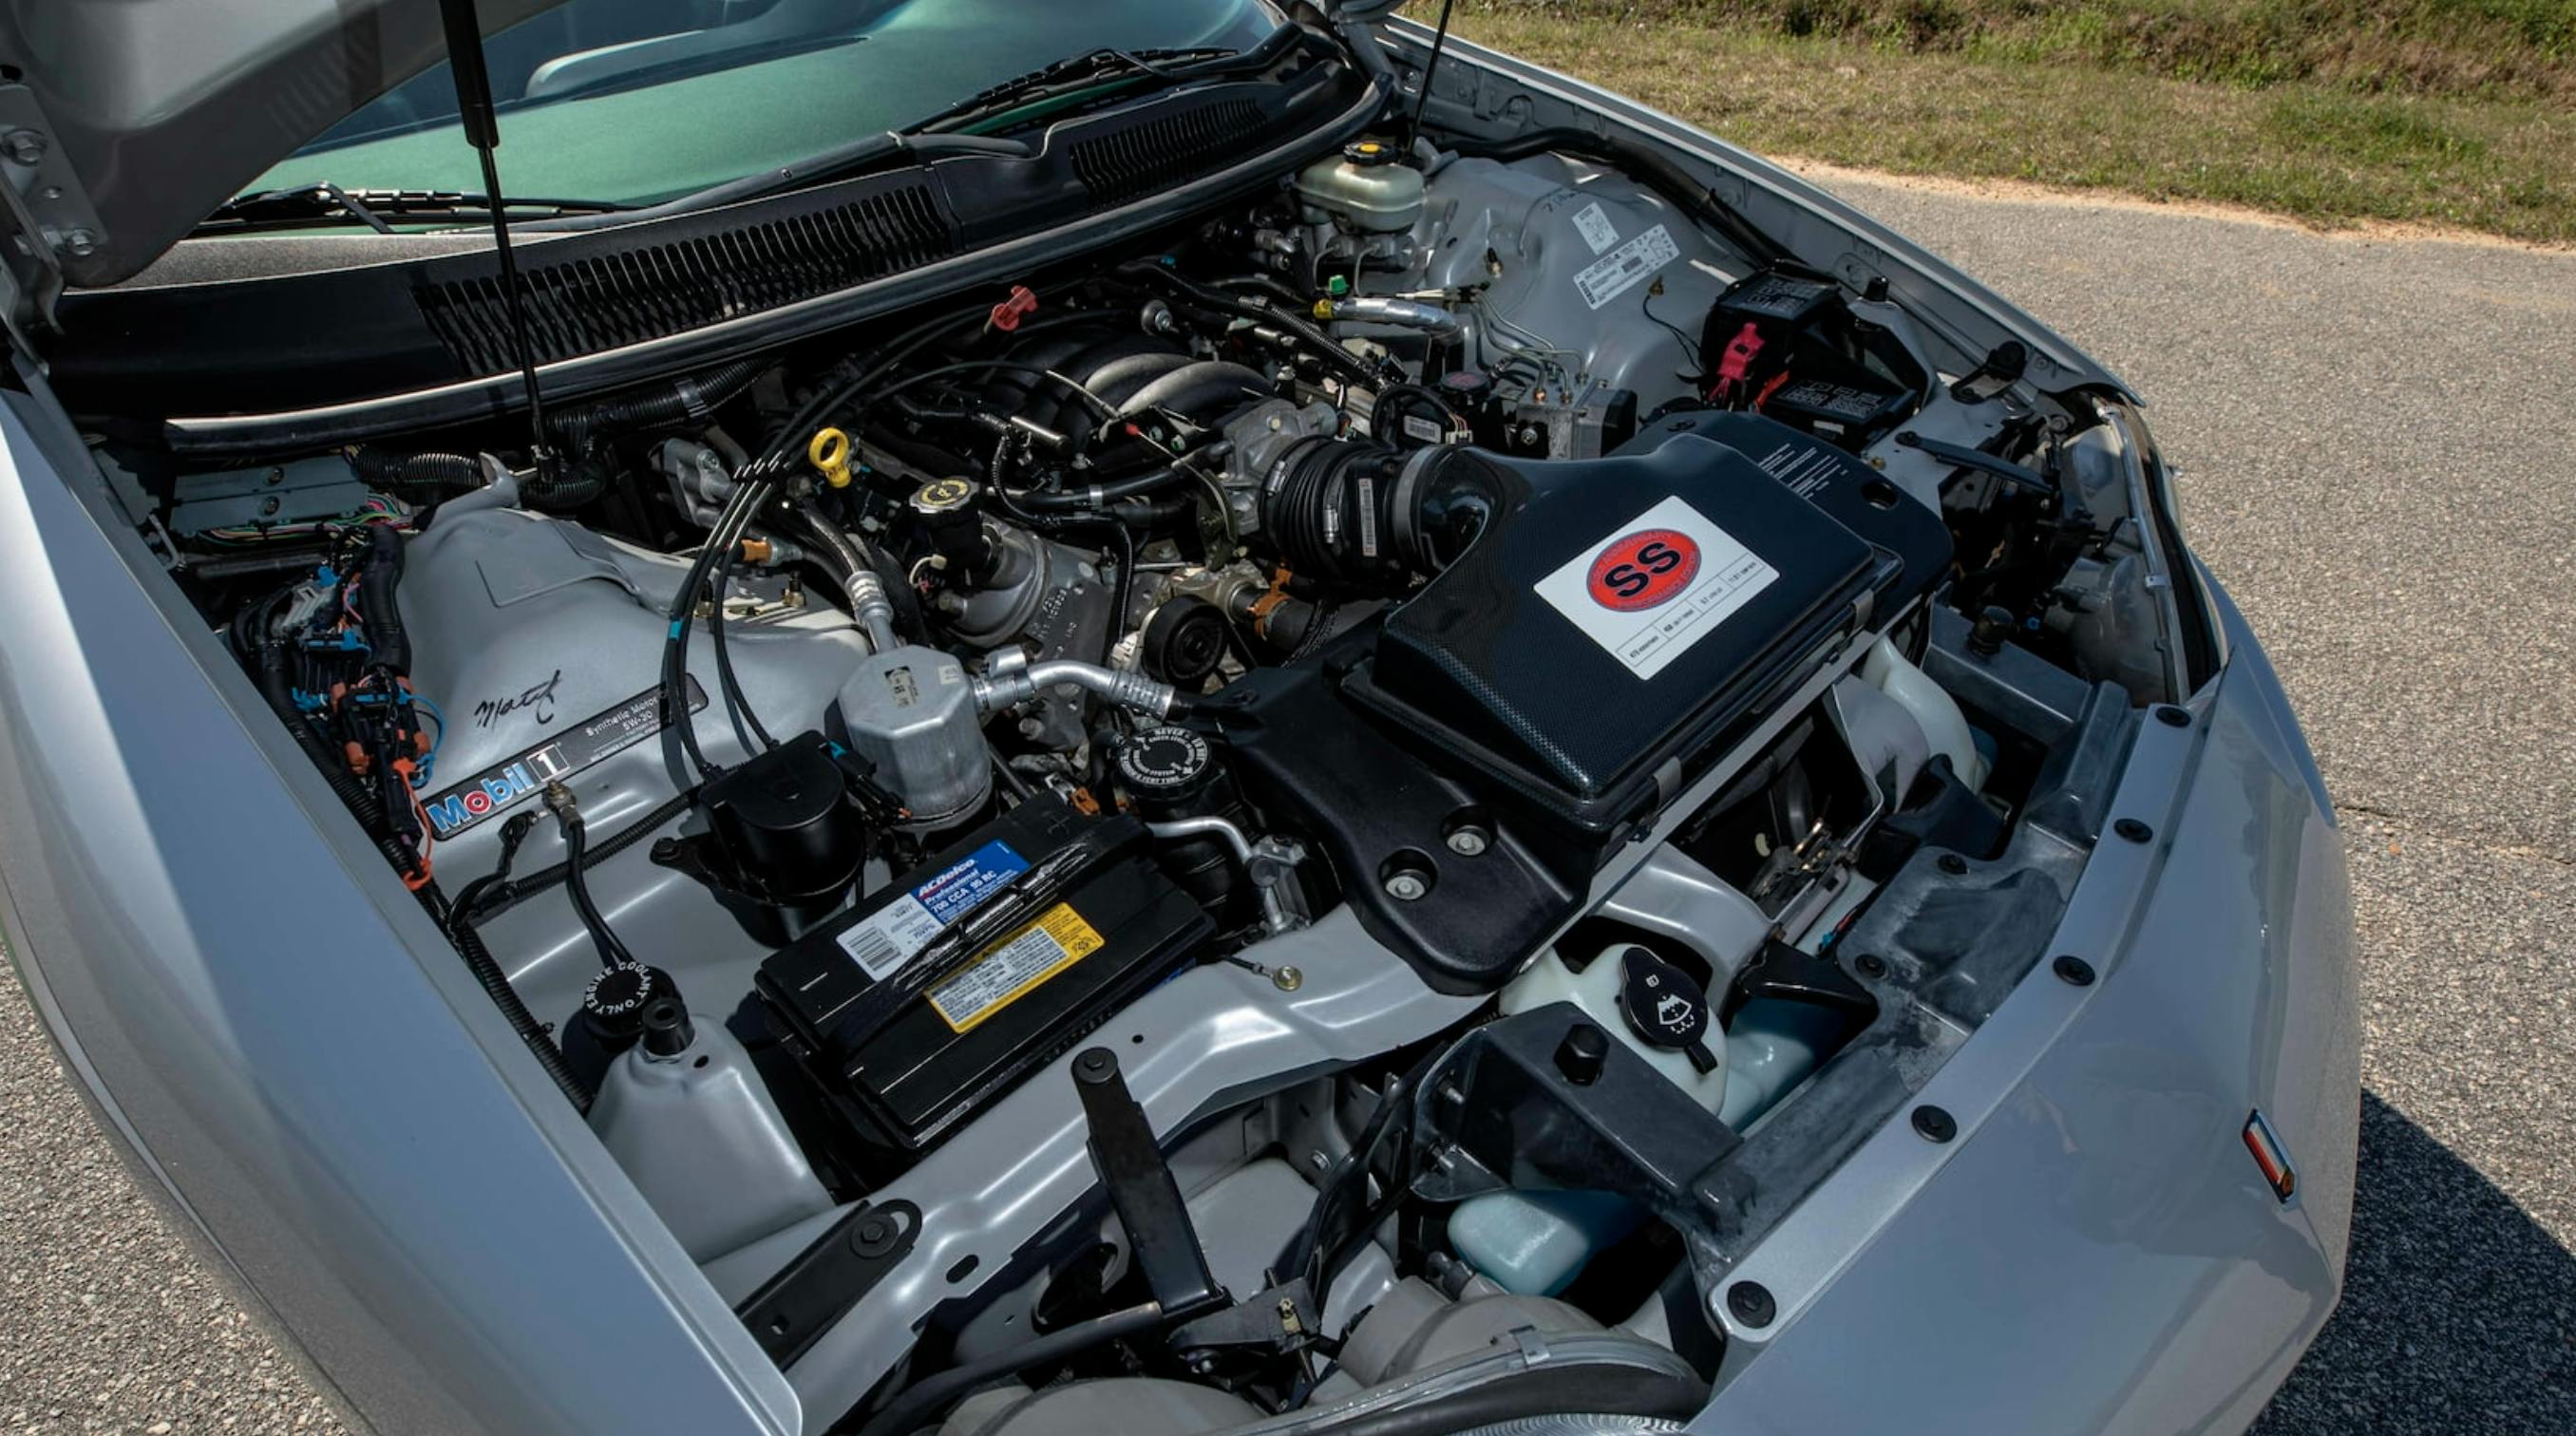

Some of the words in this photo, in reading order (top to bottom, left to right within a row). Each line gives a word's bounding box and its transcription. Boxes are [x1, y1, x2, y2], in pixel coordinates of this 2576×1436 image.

[1604, 542, 1680, 597] SS
[585, 709, 631, 736] Synthetic
[622, 710, 653, 730] 5W-30
[1154, 727, 1186, 736] NEVER
[426, 763, 535, 833] Mobil
[919, 859, 975, 897] ACDelco
[924, 868, 980, 905] Professional
[948, 887, 970, 903] CCA
[981, 870, 997, 882] RC
[585, 967, 614, 1010] ENGINE
[617, 961, 652, 1000] COOLANT
[595, 999, 635, 1015] ONLY
